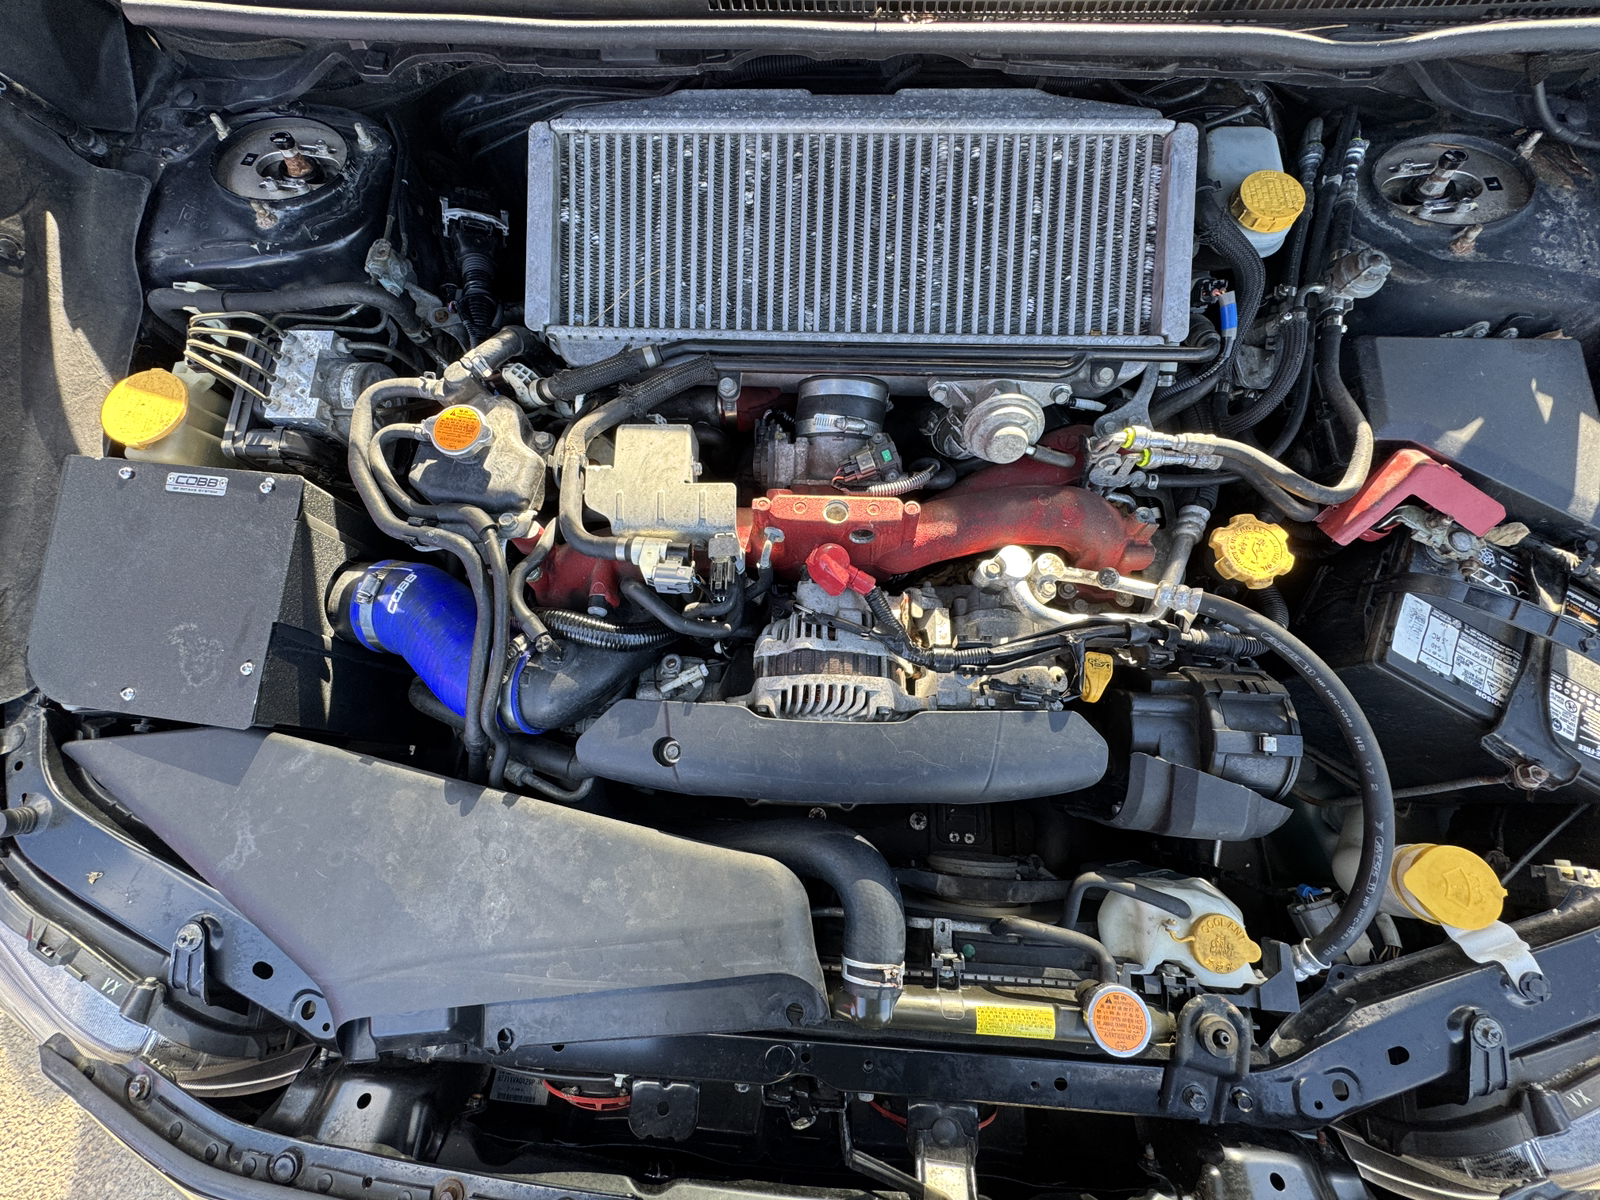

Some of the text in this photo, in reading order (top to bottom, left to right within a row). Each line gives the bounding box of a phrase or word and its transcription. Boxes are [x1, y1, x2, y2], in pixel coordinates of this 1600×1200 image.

[175, 475, 219, 488] COBB
[387, 573, 417, 614] COBB
[1316, 677, 1326, 688] HP
[1201, 917, 1246, 941] COOLANT
